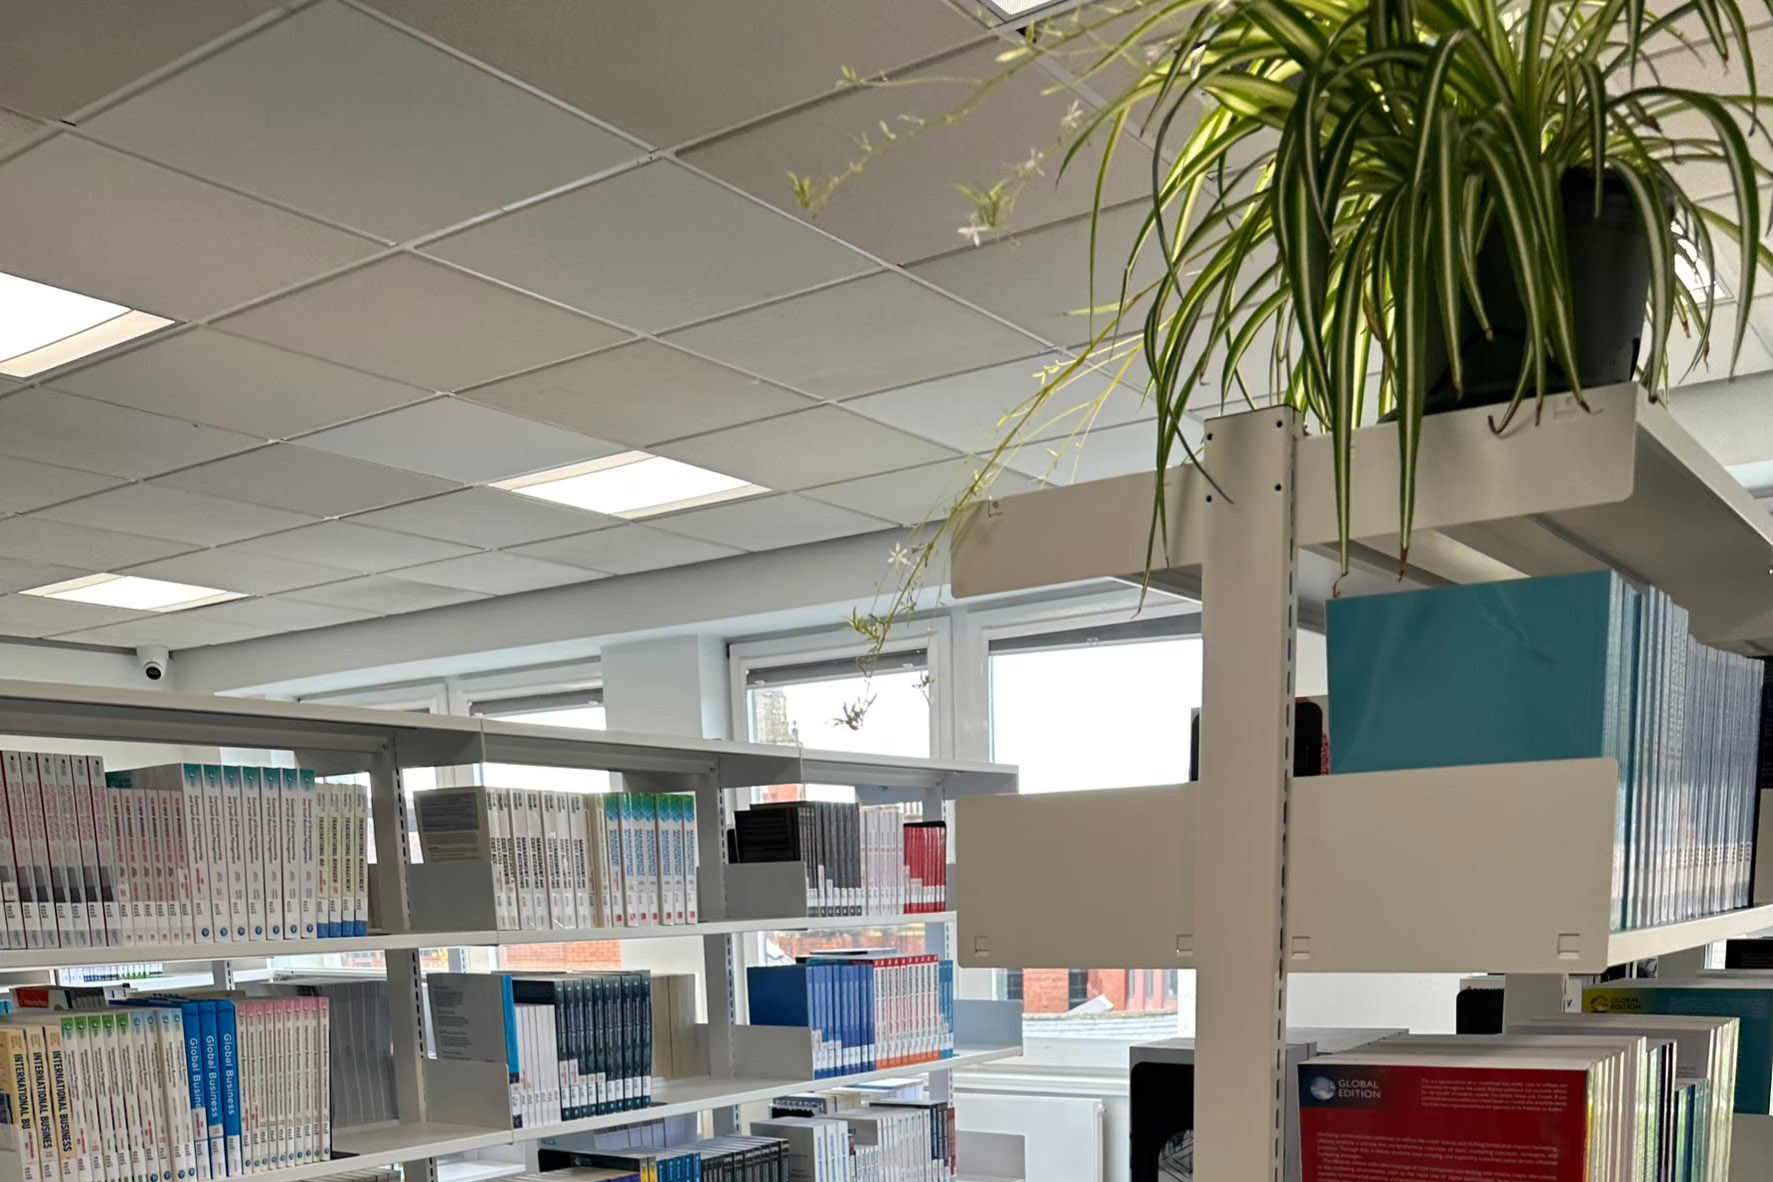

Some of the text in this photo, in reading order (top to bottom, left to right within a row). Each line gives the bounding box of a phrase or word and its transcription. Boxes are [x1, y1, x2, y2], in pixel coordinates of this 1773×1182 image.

[14, 1054, 29, 1116] INTERNATIONAL
[33, 1052, 52, 1149] INTERNATIONAL BUSINES
[52, 1050, 72, 1152] INTERNATIONAL BUSINESS
[189, 1038, 202, 1108] Global Busine
[206, 1035, 218, 1118] Global Business
[223, 1033, 235, 1115] Global Business
[1338, 1079, 1378, 1089] GLOBAL
[1338, 1089, 1380, 1098] EDITION
